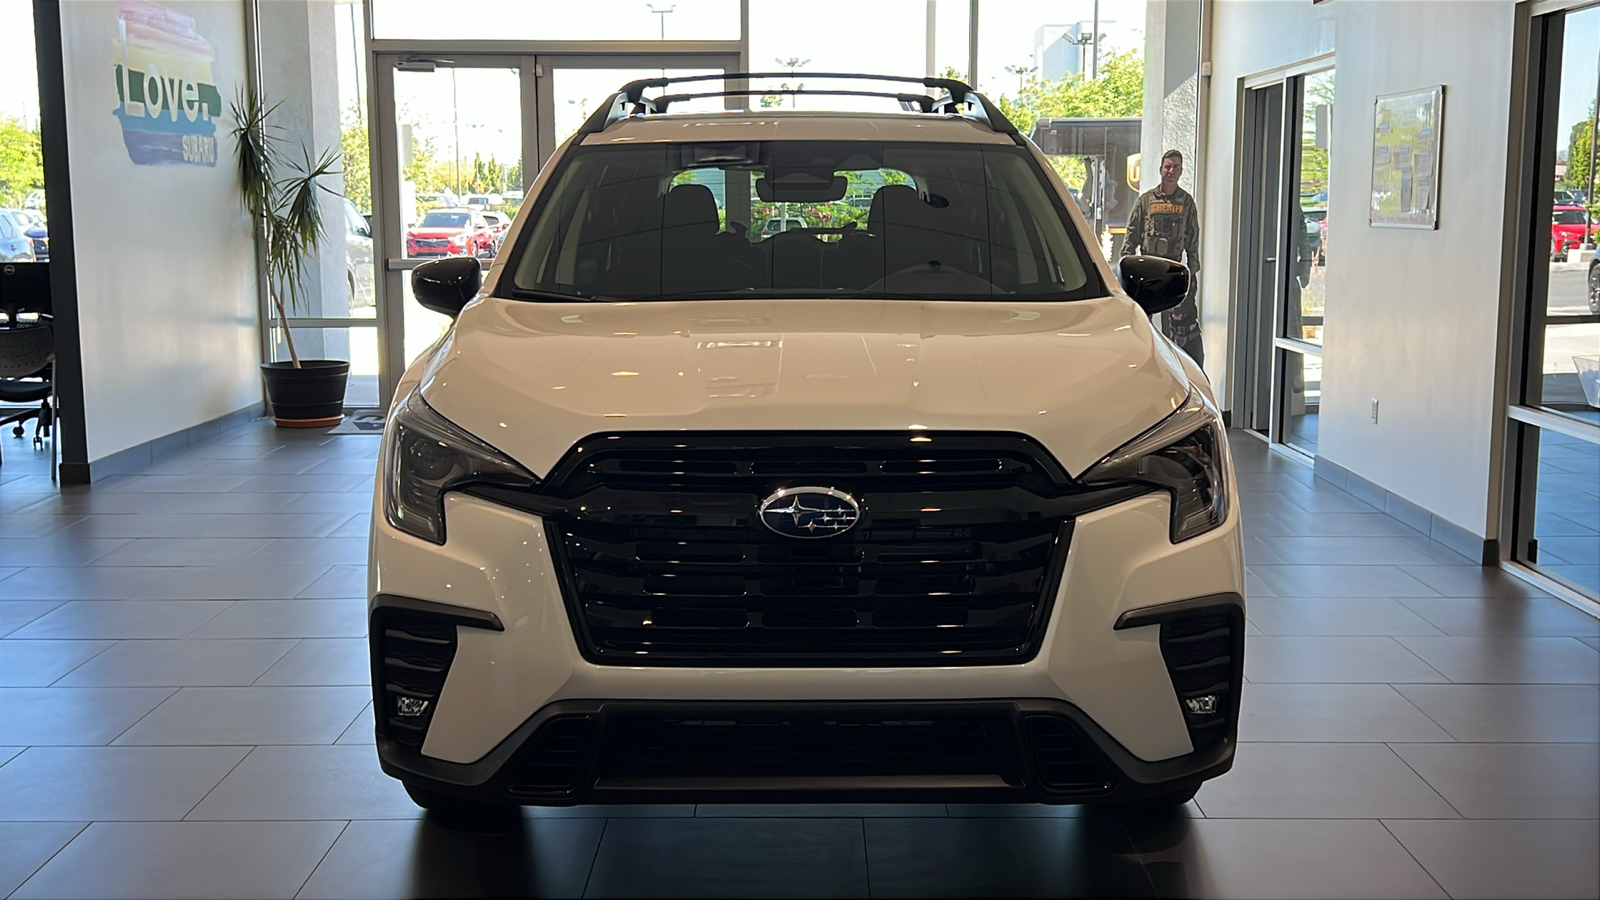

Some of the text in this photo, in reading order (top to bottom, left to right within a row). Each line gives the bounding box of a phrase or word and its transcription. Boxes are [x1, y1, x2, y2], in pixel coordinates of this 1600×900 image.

[118, 18, 209, 122] Love.
[182, 135, 214, 163] SUBARU
[1151, 203, 1183, 213] SHERIFF
